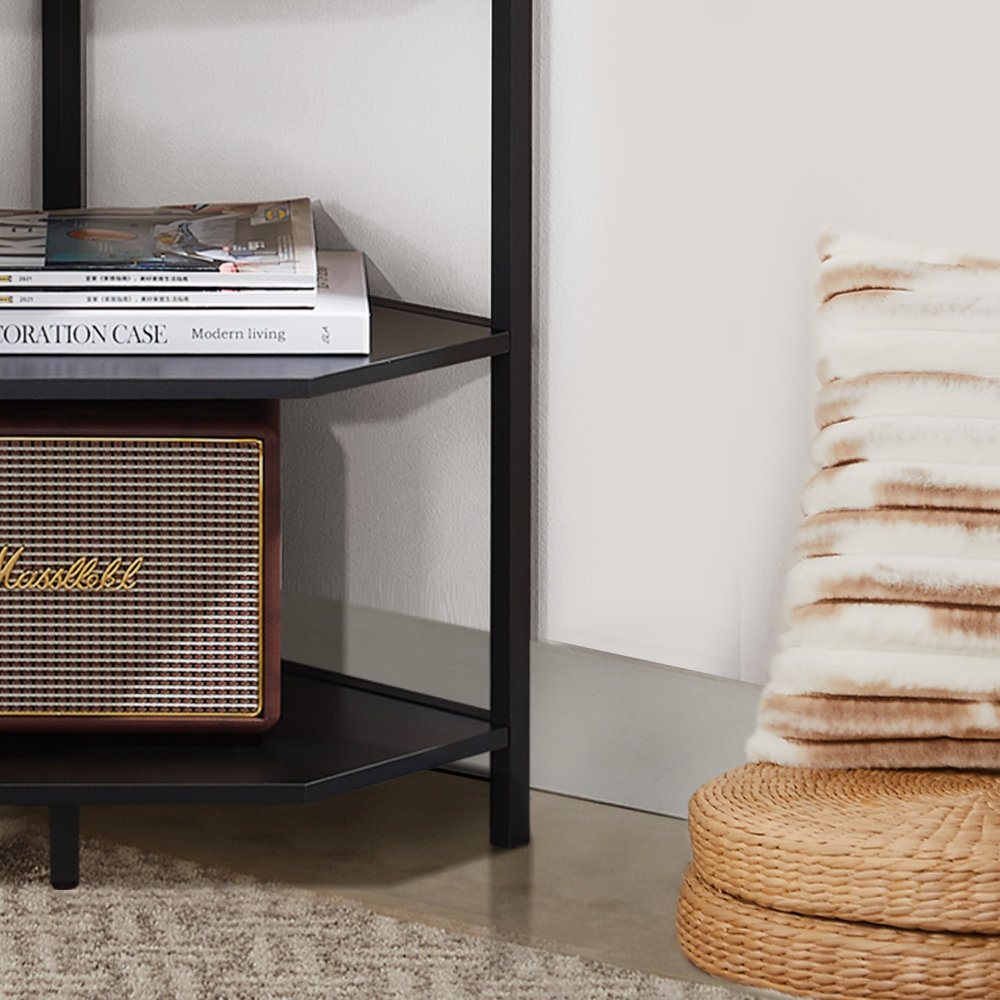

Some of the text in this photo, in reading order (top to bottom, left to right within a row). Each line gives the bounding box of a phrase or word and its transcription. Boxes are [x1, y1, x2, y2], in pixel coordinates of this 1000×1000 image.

[112, 323, 168, 345] CASE
[191, 327, 244, 340] Modern
[248, 327, 286, 342] living
